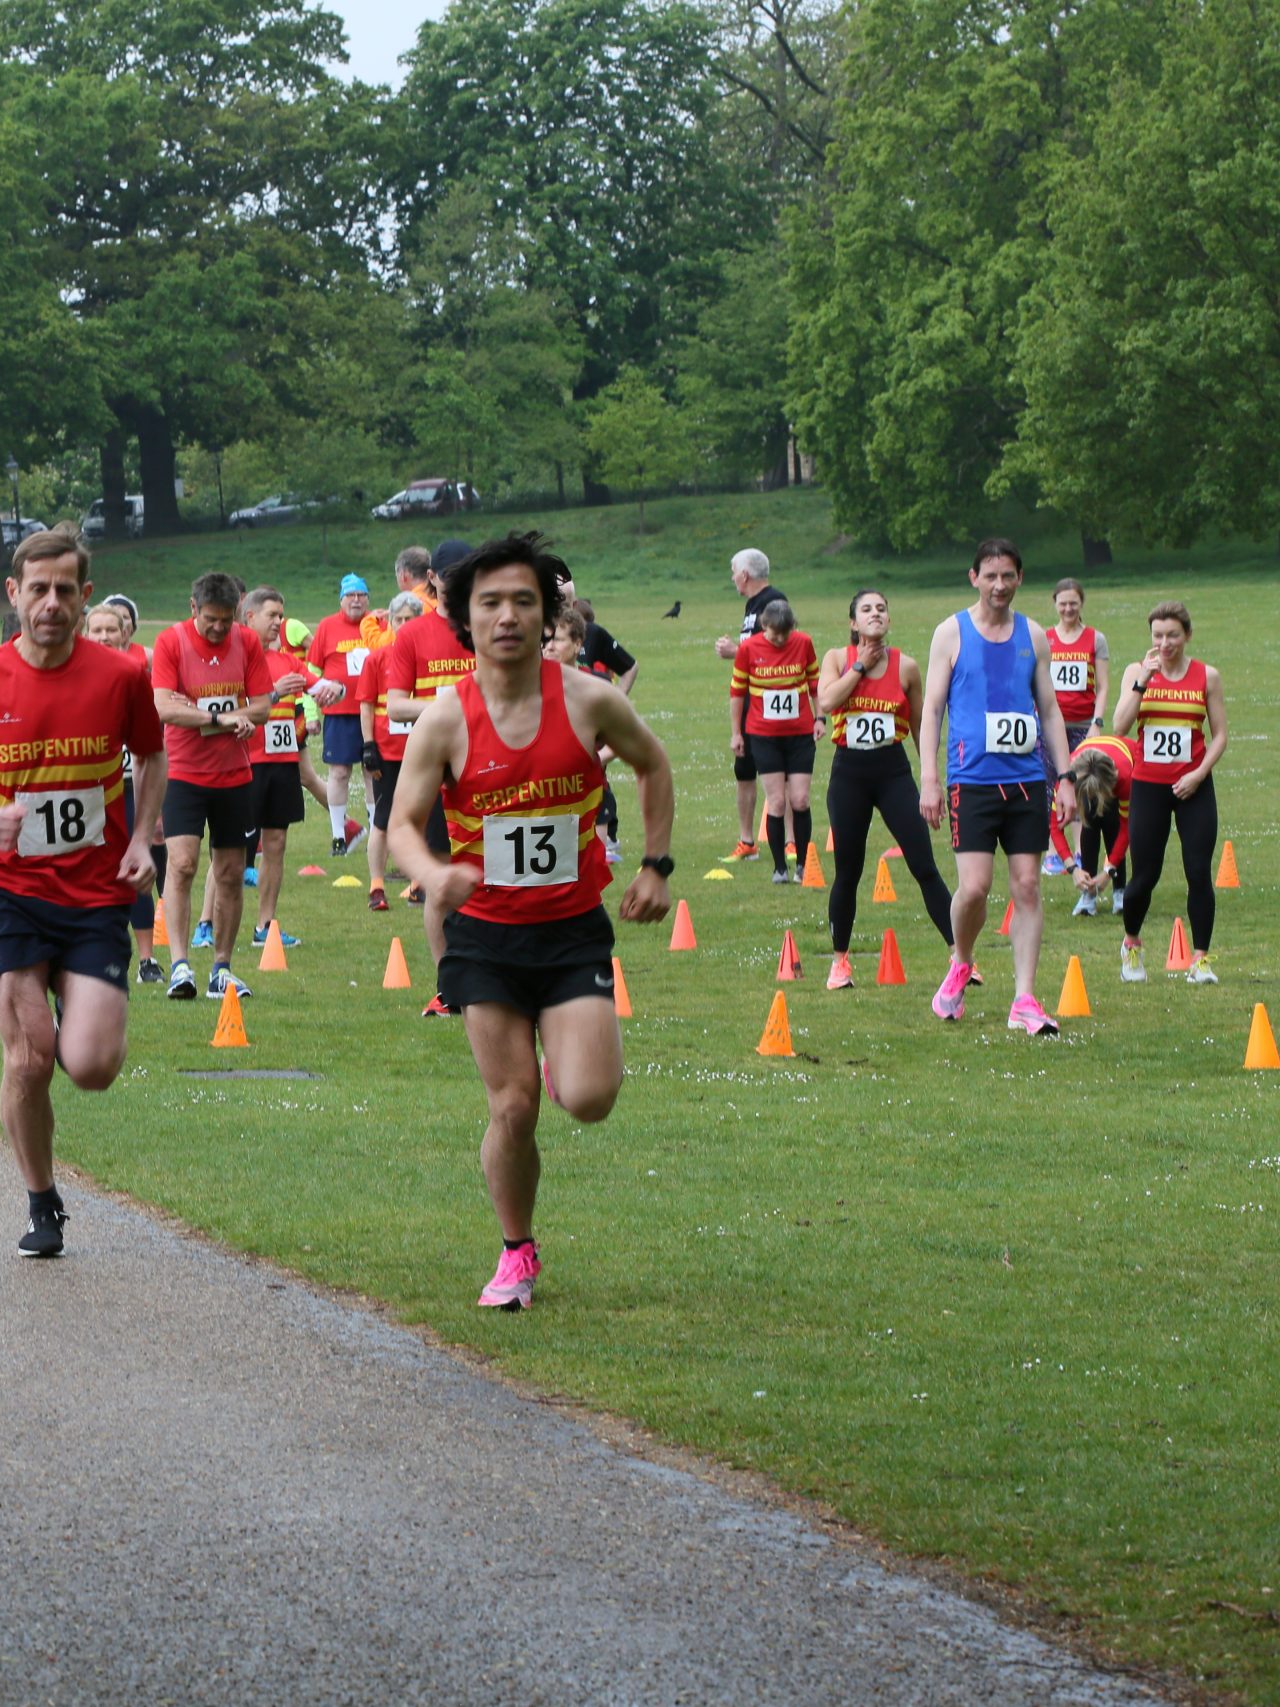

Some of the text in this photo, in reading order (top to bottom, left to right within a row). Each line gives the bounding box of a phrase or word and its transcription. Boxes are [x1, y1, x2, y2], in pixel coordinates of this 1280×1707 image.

[1057, 665, 1079, 685] 48
[771, 694, 792, 714] 44
[272, 724, 292, 747] 38
[856, 718, 885, 743] 26
[996, 719, 1027, 746] 20
[1153, 731, 1181, 757] 28
[472, 774, 584, 810] SERPENTINE
[35, 798, 86, 844] 18
[504, 825, 557, 875] 13
